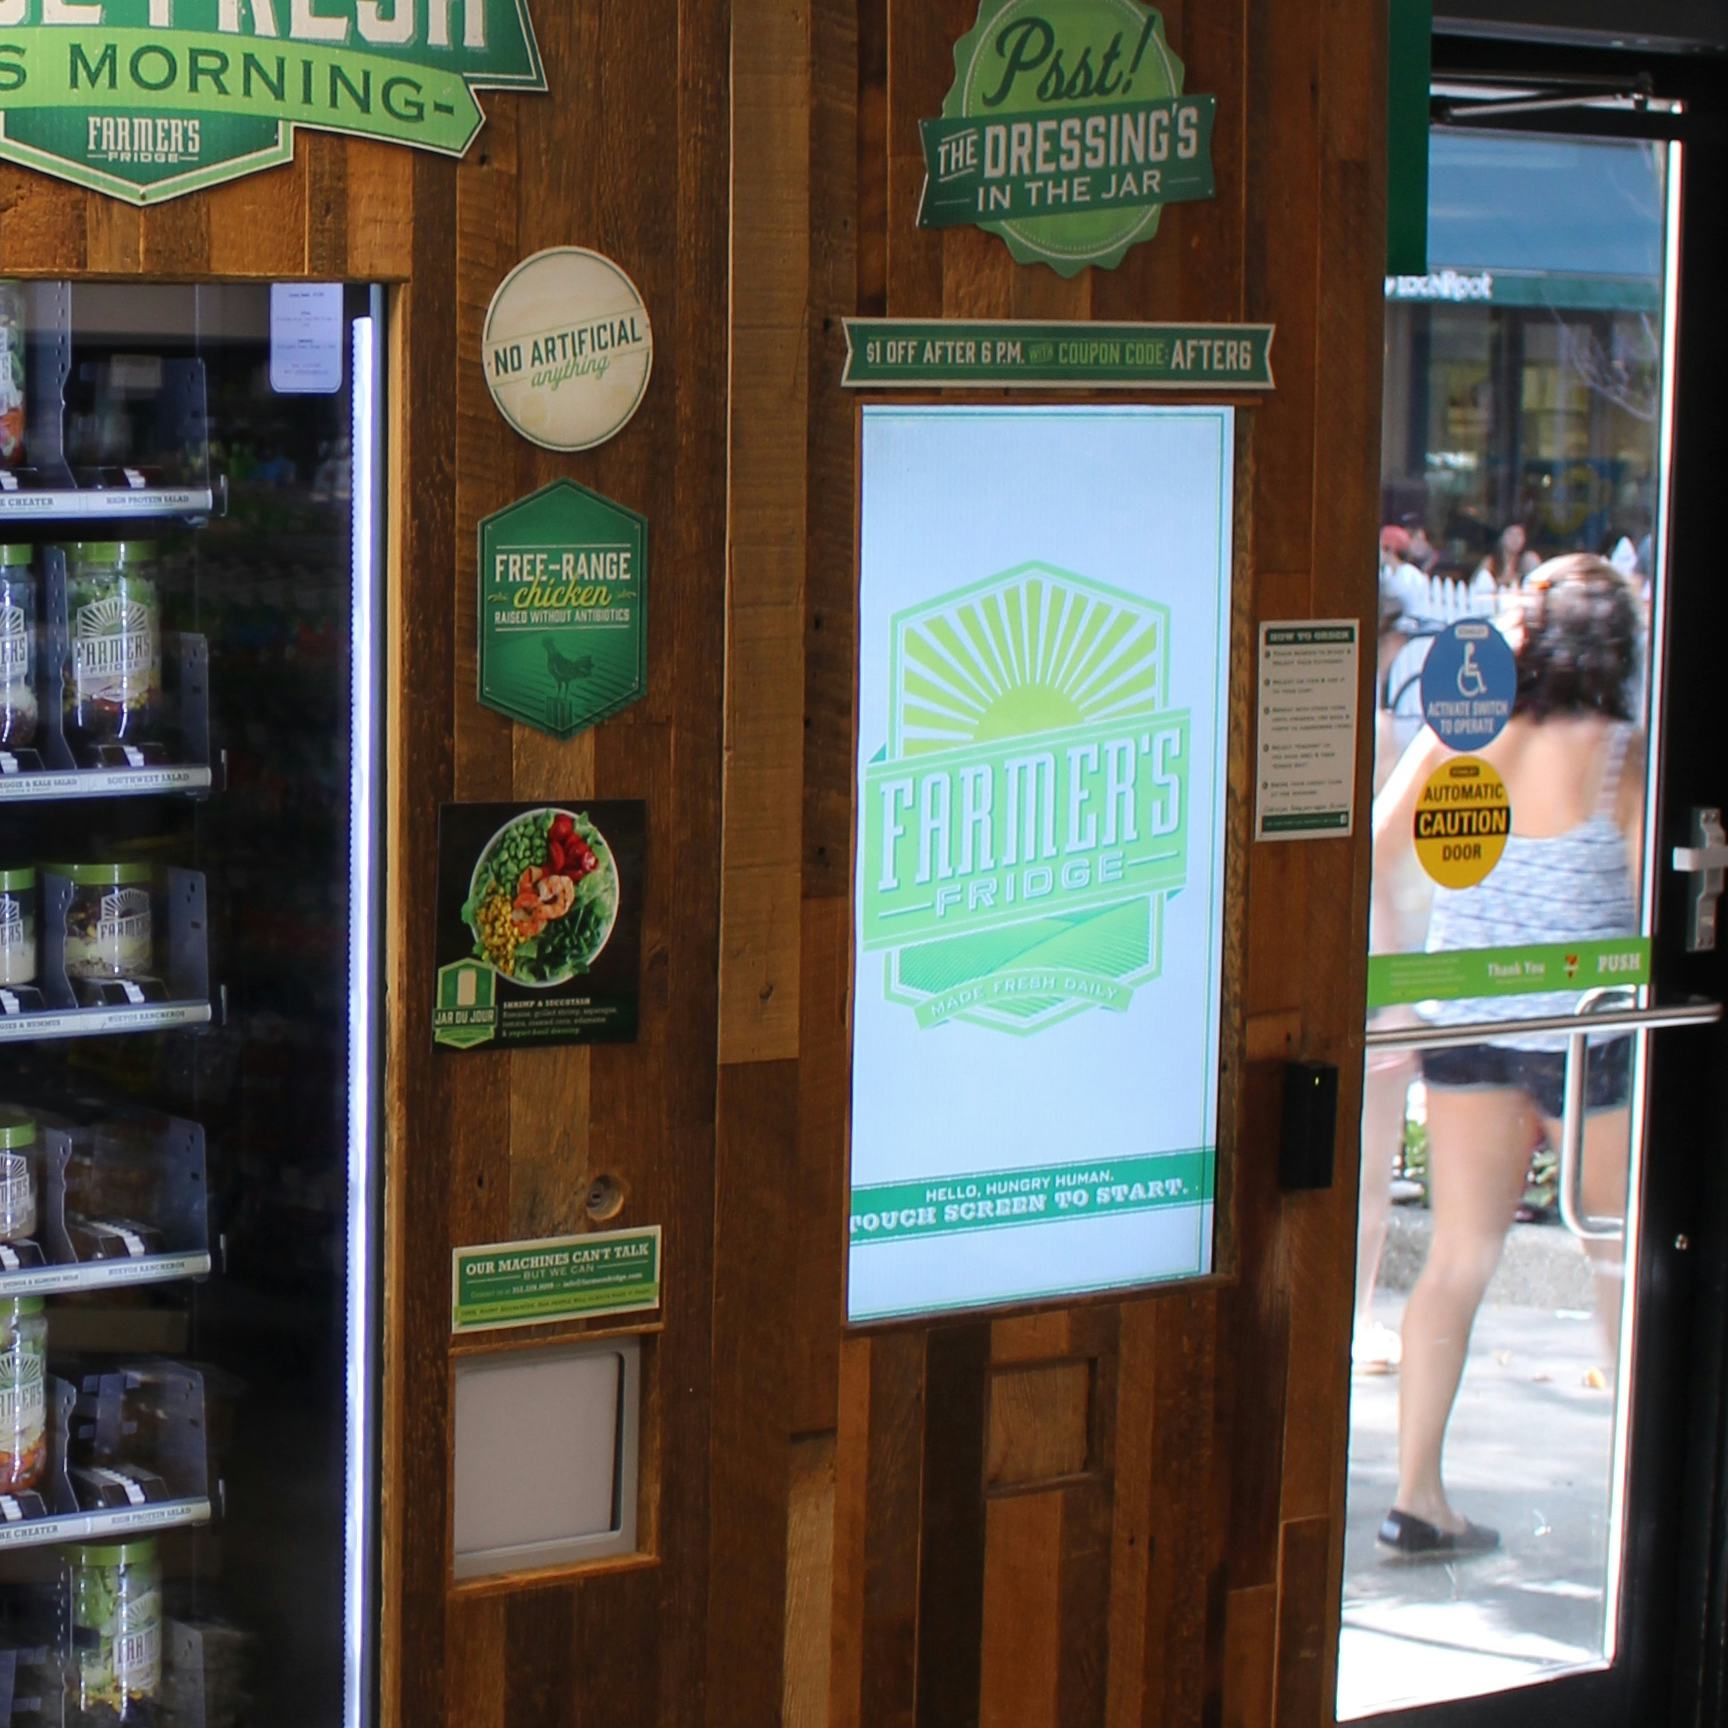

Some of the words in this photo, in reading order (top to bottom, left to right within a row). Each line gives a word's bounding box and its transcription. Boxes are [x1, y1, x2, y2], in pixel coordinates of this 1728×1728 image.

[982, 14, 1156, 107] Psst!
[88, 116, 200, 153] FARMER'S
[937, 137, 978, 175] THE
[983, 104, 1198, 179] DRESSING'S
[108, 151, 179, 163] FRIDGE
[977, 184, 1011, 212] IN
[1025, 177, 1091, 206] THE
[1101, 172, 1161, 199] JAR
[494, 343, 523, 376] NO
[530, 316, 643, 369] ARTIFICIAL
[866, 341, 881, 364] $1
[886, 342, 916, 364] OFF
[923, 341, 975, 364] AFTER
[980, 341, 992, 364] 6
[1058, 341, 1121, 365] COUPON
[1171, 340, 1252, 370] AFTER6
[531, 353, 610, 390] anything
[494, 551, 632, 582] FREE-RANGE
[513, 574, 612, 609] chicken
[494, 610, 527, 625] RAISED
[530, 609, 572, 625] WITHOUT
[575, 608, 630, 623] ANTIBIOTICS
[1427, 700, 1471, 717] ACTIVATE
[1473, 699, 1508, 716] SWITCH
[1440, 718, 1453, 735] TO
[1454, 717, 1494, 734] OPERATE
[1424, 783, 1503, 802] AUTOMATIC
[877, 728, 1182, 893] FARMER'S
[1418, 808, 1507, 837] CAUTION
[1442, 843, 1482, 862] DOOR
[936, 850, 1125, 918] FRIDGE
[1487, 962, 1523, 977] Thank
[1524, 960, 1545, 975] You
[1597, 952, 1641, 973] PUSH
[931, 984, 986, 1018] MADE
[991, 975, 1057, 995] FRESH
[1064, 977, 1119, 1002] DAILY
[434, 1010, 454, 1025] JAR
[455, 1010, 468, 1024] DU
[469, 1009, 494, 1024] JOUR
[925, 1184, 982, 1203] HELLO,
[986, 1176, 1051, 1196] HUNGRY
[1055, 1169, 1115, 1188] HUMAN.
[850, 1206, 937, 1234] TOUCH
[944, 1194, 1047, 1223] SCREEN
[1055, 1189, 1090, 1209] TO
[1096, 1178, 1189, 1205] START.
[466, 1263, 495, 1276] OUR
[498, 1253, 570, 1273] MACHINES
[572, 1247, 611, 1264] CAN'T
[613, 1242, 649, 1258] TALK
[523, 1270, 546, 1281] BUT
[550, 1267, 567, 1277] WE
[571, 1263, 595, 1274] CAN
[14, 1525, 59, 1538] CHEATER
